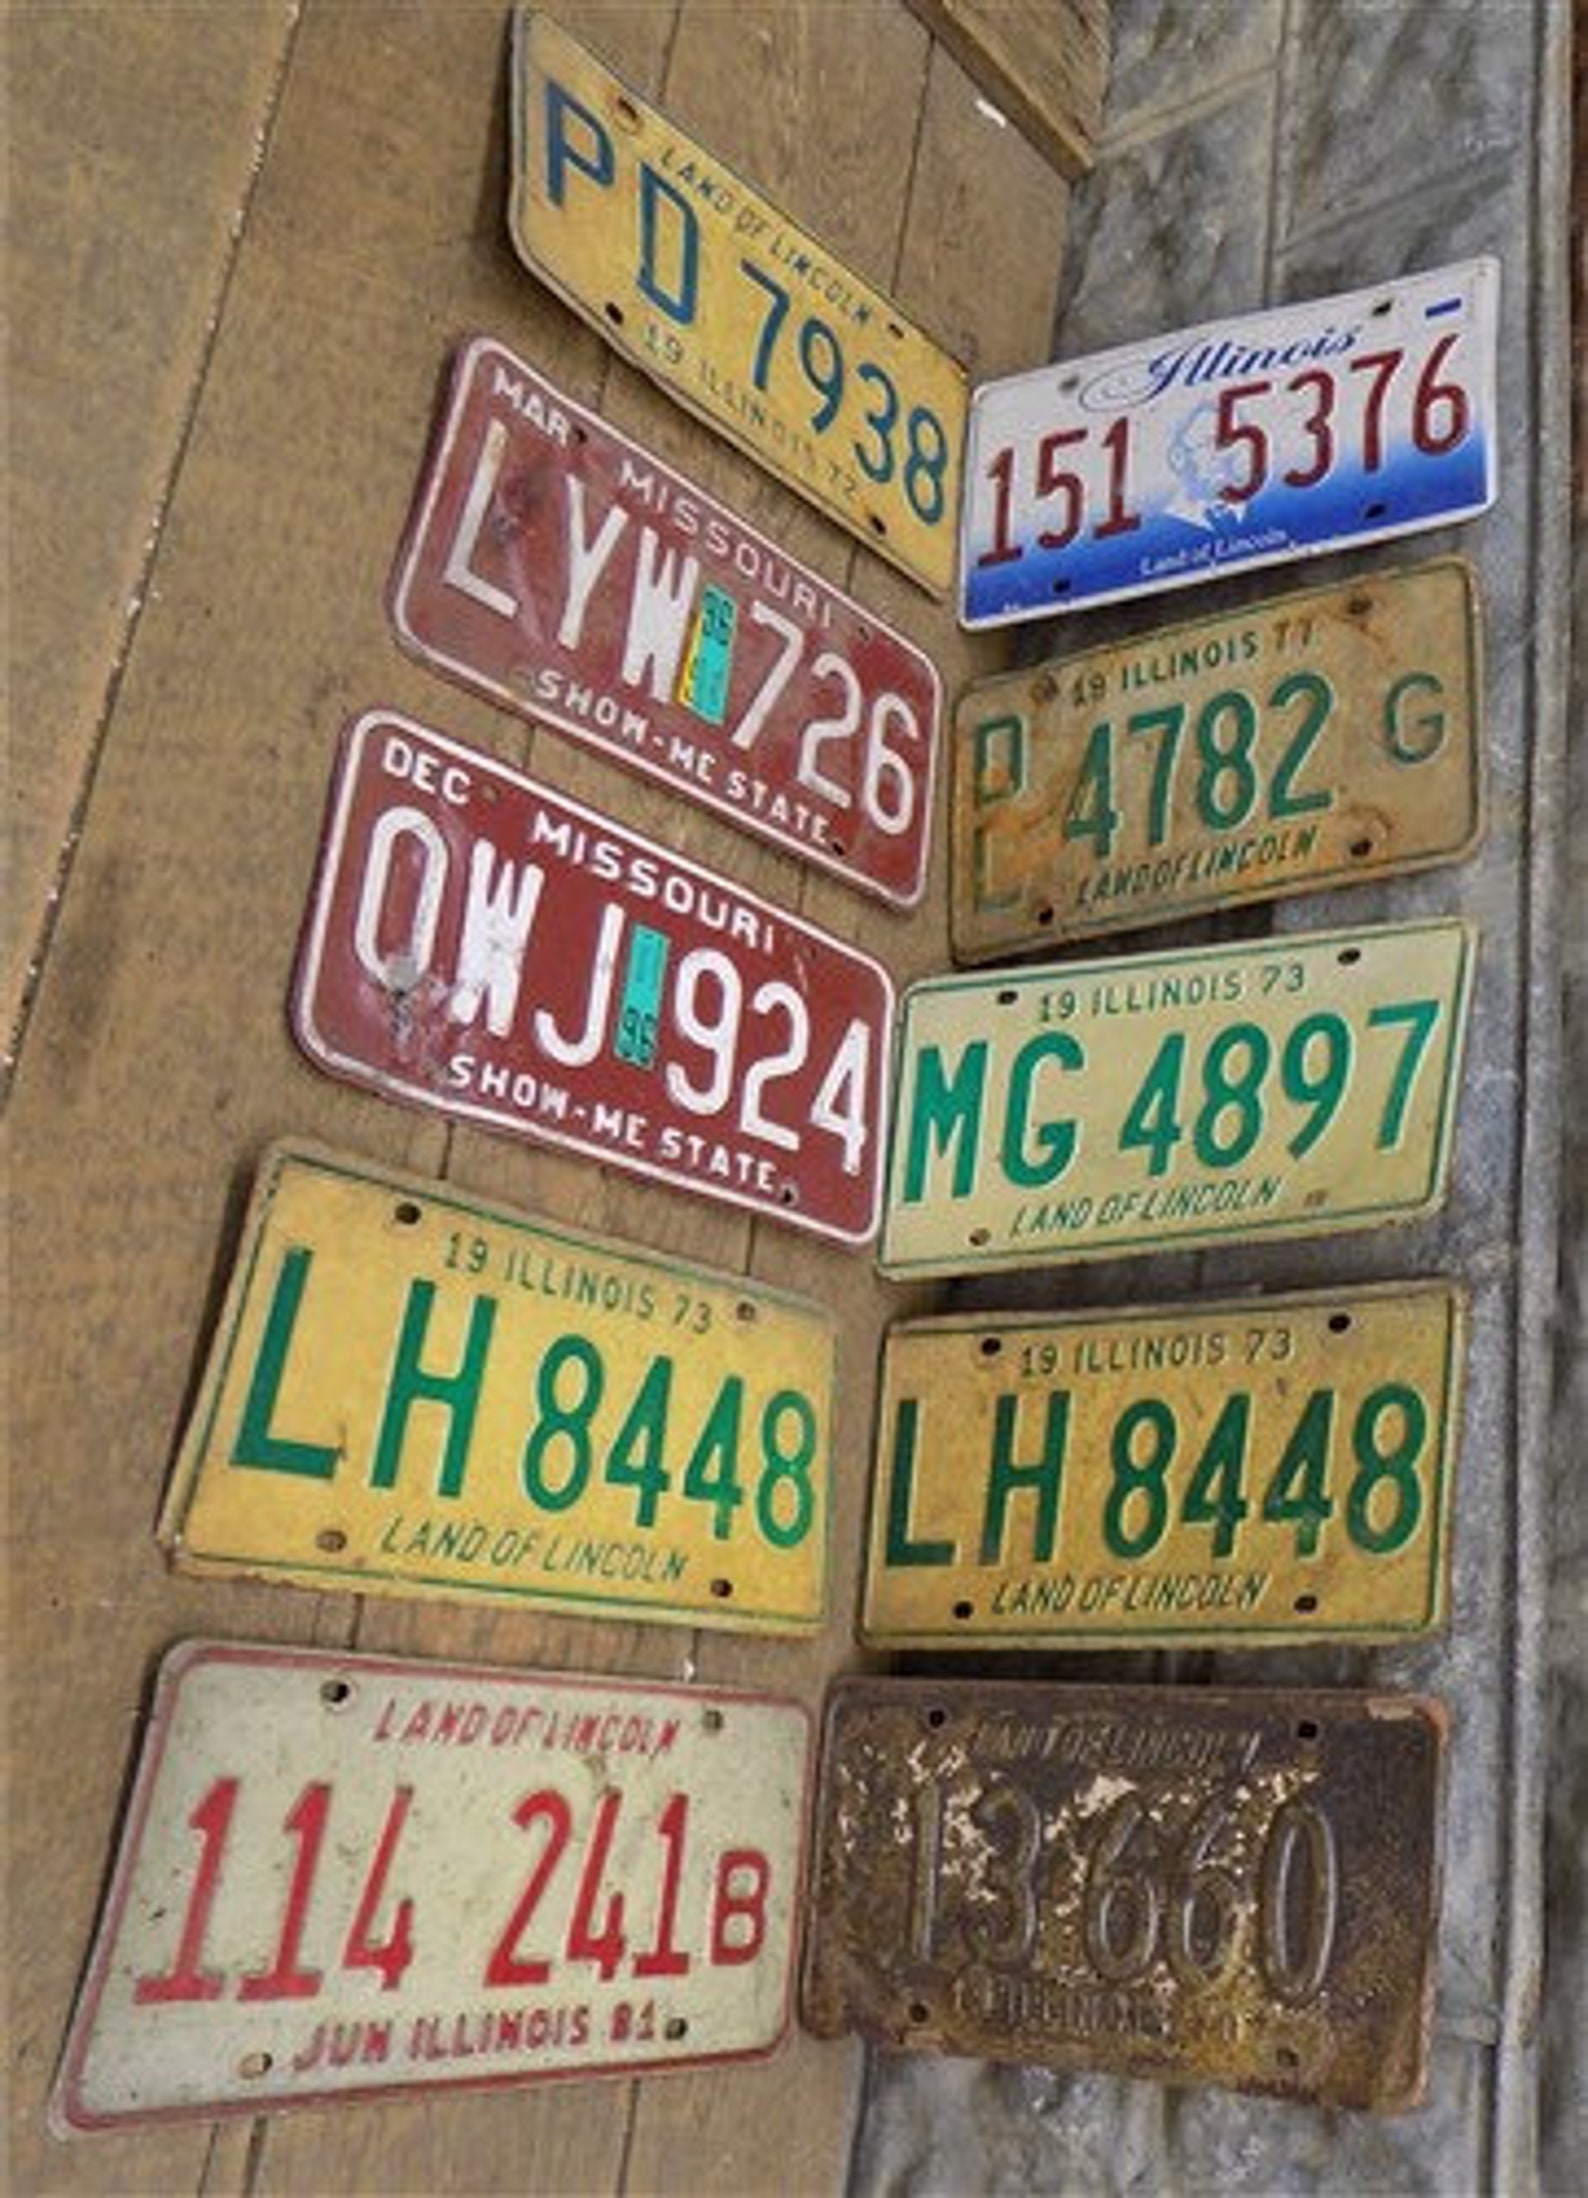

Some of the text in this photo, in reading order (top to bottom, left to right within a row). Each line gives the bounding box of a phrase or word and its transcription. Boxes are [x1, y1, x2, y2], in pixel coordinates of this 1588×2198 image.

[544, 80, 948, 524] PD 7938
[661, 147, 872, 325] LAND OF LINCOLN
[493, 366, 570, 449] MAR
[643, 323, 684, 366] 19
[701, 358, 817, 467] ILLINOIS
[1079, 324, 1363, 412] Illinois
[977, 332, 1471, 568] 151 5376
[620, 460, 834, 627] MISSOURI
[443, 418, 919, 835] LYW 726
[1121, 630, 1260, 690] ILLINOIS
[382, 738, 471, 803] DEC
[534, 668, 830, 844] SHOW-ME STATE
[1066, 672, 1446, 858] 4782 G
[531, 811, 774, 952] MISSOURI
[665, 947, 871, 1177] 924
[1039, 965, 1306, 1022] 19 ILLINOIS 73
[447, 1055, 776, 1190] SHOW-ME STATE
[903, 999, 1440, 1203] MG 4897
[1009, 1197, 1093, 1238] LAND
[1140, 1176, 1282, 1220] LINCOLN
[444, 1231, 713, 1335] 19 ILLINOIS 73
[1020, 1329, 1294, 1376] 19 ILLINOIS 73
[229, 1246, 816, 1548] LH 8448
[885, 1382, 1428, 1566] LH 8448
[380, 1517, 688, 1581] LAND OF LINCOLN
[991, 1573, 1075, 1614] LAND
[1124, 1571, 1272, 1611] LINCOLN
[373, 1698, 680, 1757] LAND OF LINCOLN
[132, 1777, 770, 2004] 114 241 B
[292, 2021, 393, 2072] JUN
[409, 2005, 589, 2061] ILLINOIS
